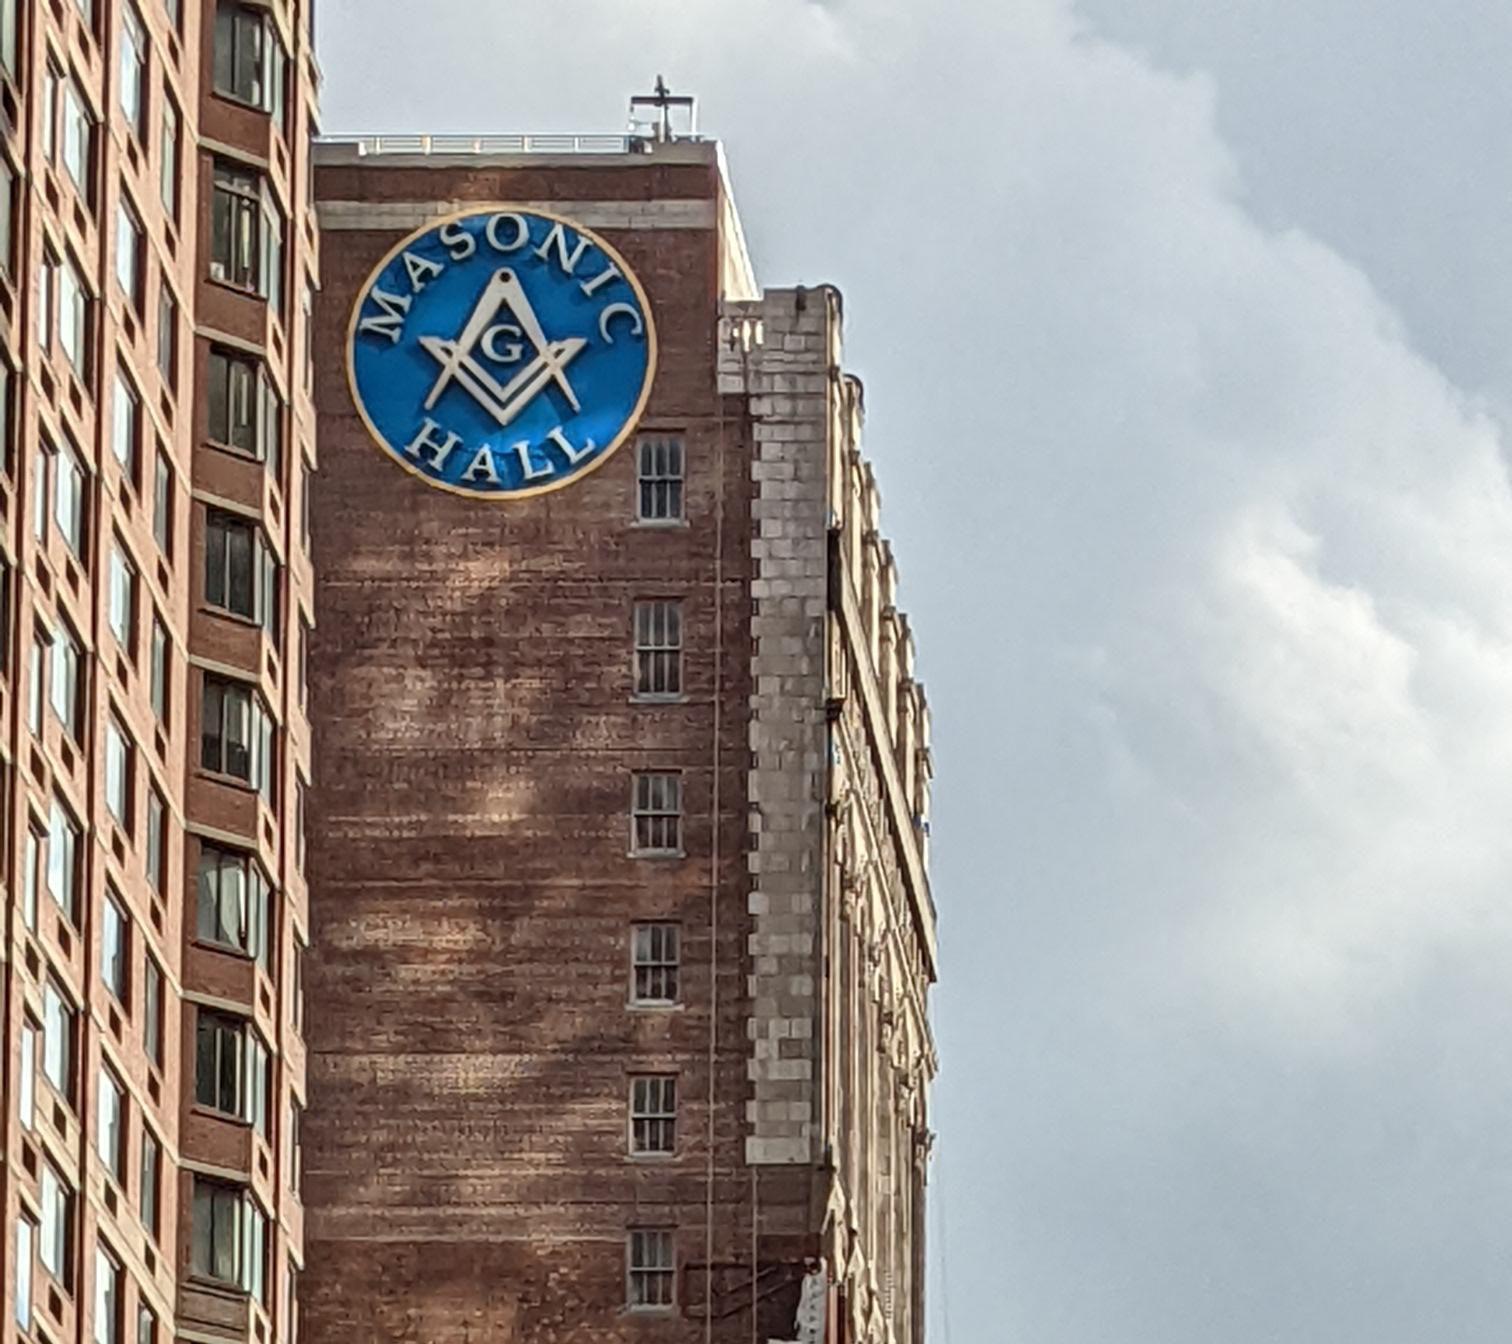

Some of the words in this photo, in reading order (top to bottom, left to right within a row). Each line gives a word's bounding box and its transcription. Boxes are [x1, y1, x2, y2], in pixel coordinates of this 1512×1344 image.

[358, 212, 643, 345] MASONIC
[480, 324, 524, 363] G
[404, 416, 596, 485] HALL
